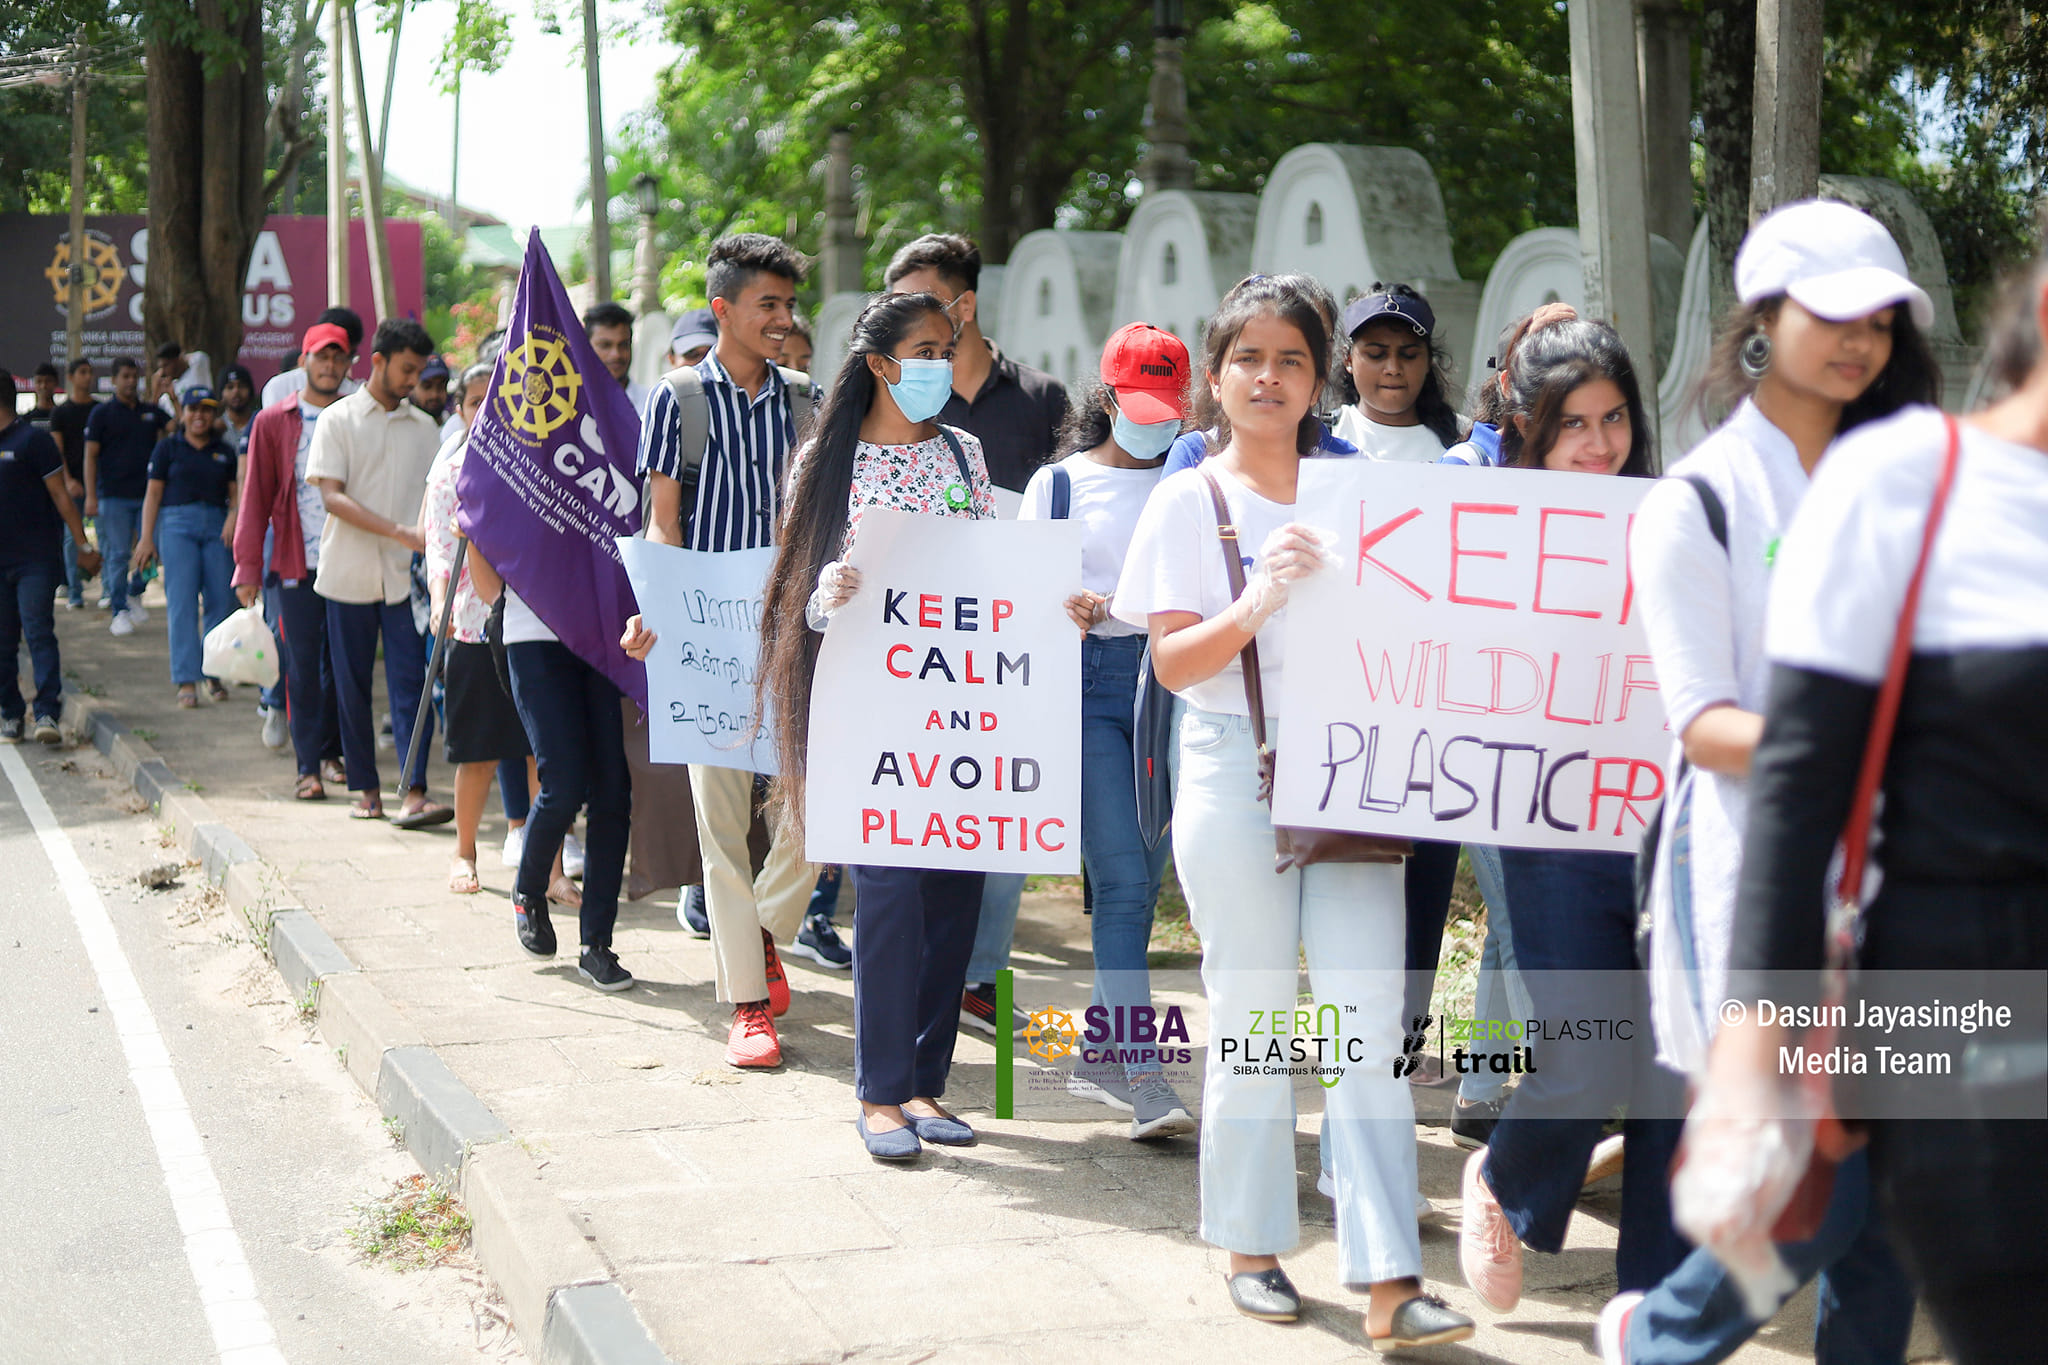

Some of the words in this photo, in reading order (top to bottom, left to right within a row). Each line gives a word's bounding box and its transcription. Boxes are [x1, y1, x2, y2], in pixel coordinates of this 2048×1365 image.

[1140, 364, 1173, 377] PUMA
[468, 437, 494, 465] allekele,
[492, 460, 526, 502] Kundasale,
[526, 497, 541, 512] Sri
[538, 507, 565, 534] Lanka
[486, 437, 511, 464] Higher
[508, 460, 555, 507] Educational
[552, 501, 589, 535] Institute
[588, 531, 602, 543] of
[597, 537, 613, 553] Sri
[490, 424, 521, 458] LANKA
[519, 454, 600, 526] INTERNATIONAL
[883, 588, 1014, 632] KEEP
[886, 643, 1030, 686] CALM
[1356, 638, 1664, 731] WILDLIF
[925, 710, 998, 732] AND
[871, 752, 1041, 792] AVOID
[862, 808, 1065, 852] PLASTIC
